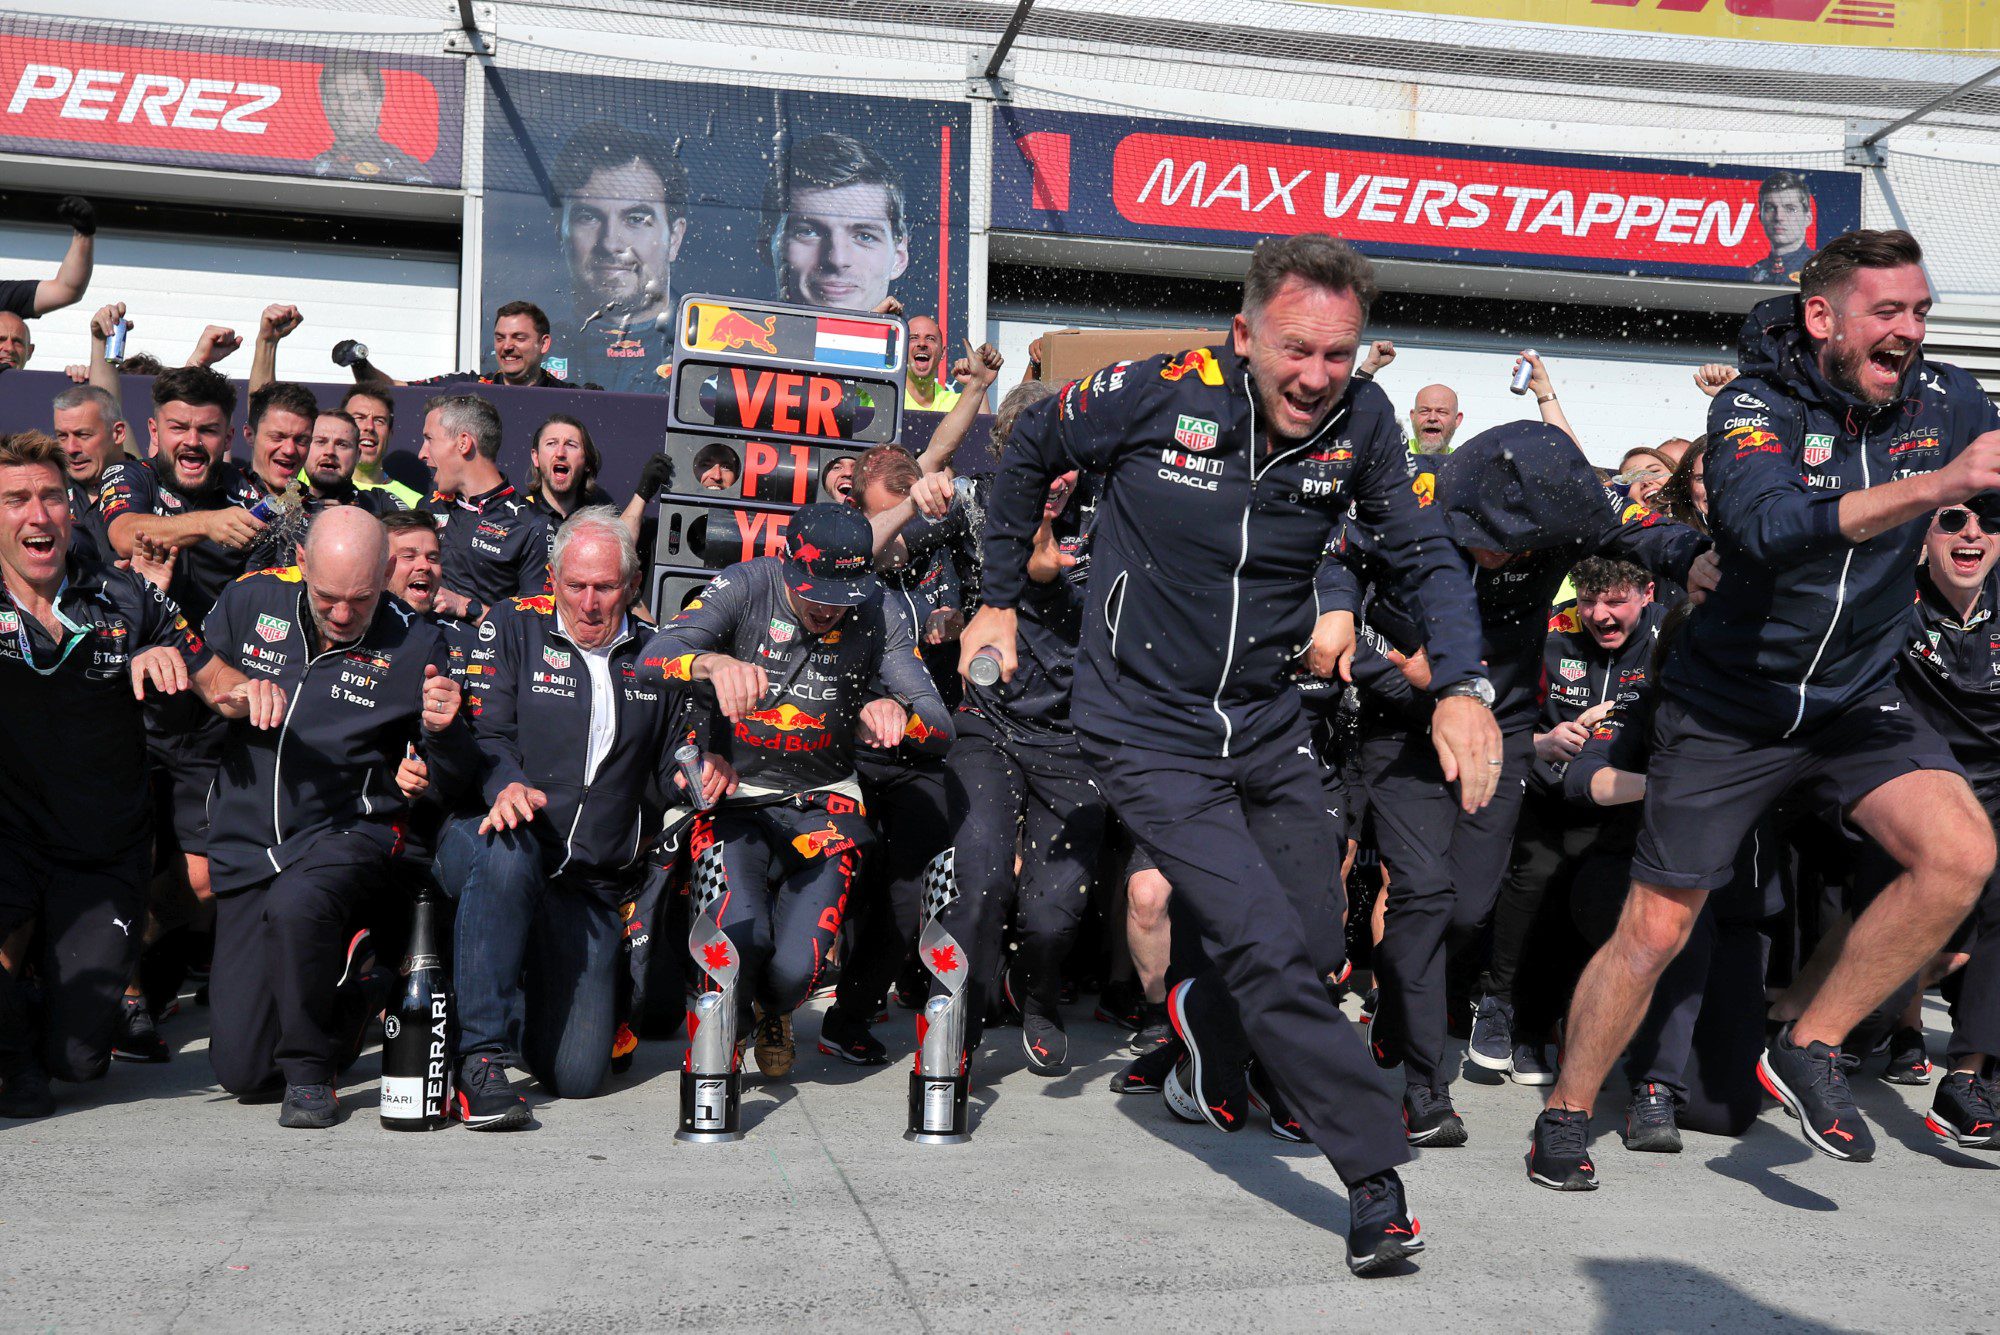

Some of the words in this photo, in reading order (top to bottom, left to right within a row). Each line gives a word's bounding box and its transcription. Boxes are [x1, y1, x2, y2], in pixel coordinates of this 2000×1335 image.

[7, 63, 282, 134] PEREZ
[1136, 158, 1312, 215] MAX
[1324, 172, 1755, 247] VERSTAPPEN
[730, 368, 843, 438] VER
[1181, 418, 1215, 435] TAG
[1724, 416, 1762, 430] Claro
[1177, 430, 1214, 450] HEUER
[1890, 427, 1938, 446] ORACLE
[1161, 449, 1206, 472] Mobil
[1805, 449, 1830, 464] EUER
[742, 441, 811, 505] P1
[1158, 468, 1219, 491] ORACLE
[1802, 473, 1825, 487] bil
[1301, 477, 1344, 496] BYBIT
[479, 540, 501, 554] Tezos
[1076, 553, 1091, 564] zos
[711, 575, 730, 589] bil
[261, 616, 287, 631] TAG
[773, 620, 793, 633] TAG
[243, 643, 275, 662] Mobil
[471, 649, 490, 660] Claro
[809, 653, 839, 665] BYBIT
[241, 658, 281, 675] ORACLE
[1562, 660, 1585, 669] TAG
[340, 670, 378, 690] BYBIT
[533, 672, 565, 686] Mobil
[532, 685, 575, 698] ORACLE
[634, 690, 657, 701] Tezos
[765, 681, 838, 700] RACLE
[1551, 683, 1579, 696] Mobil
[343, 689, 376, 708] Tezos
[1550, 694, 1588, 707] ORACLE
[734, 721, 782, 750] Red
[784, 732, 832, 752] Bull
[631, 934, 649, 948] App
[388, 1021, 395, 1033] 1
[425, 992, 447, 1117] FERRARI
[380, 1093, 412, 1104] ERRARI
